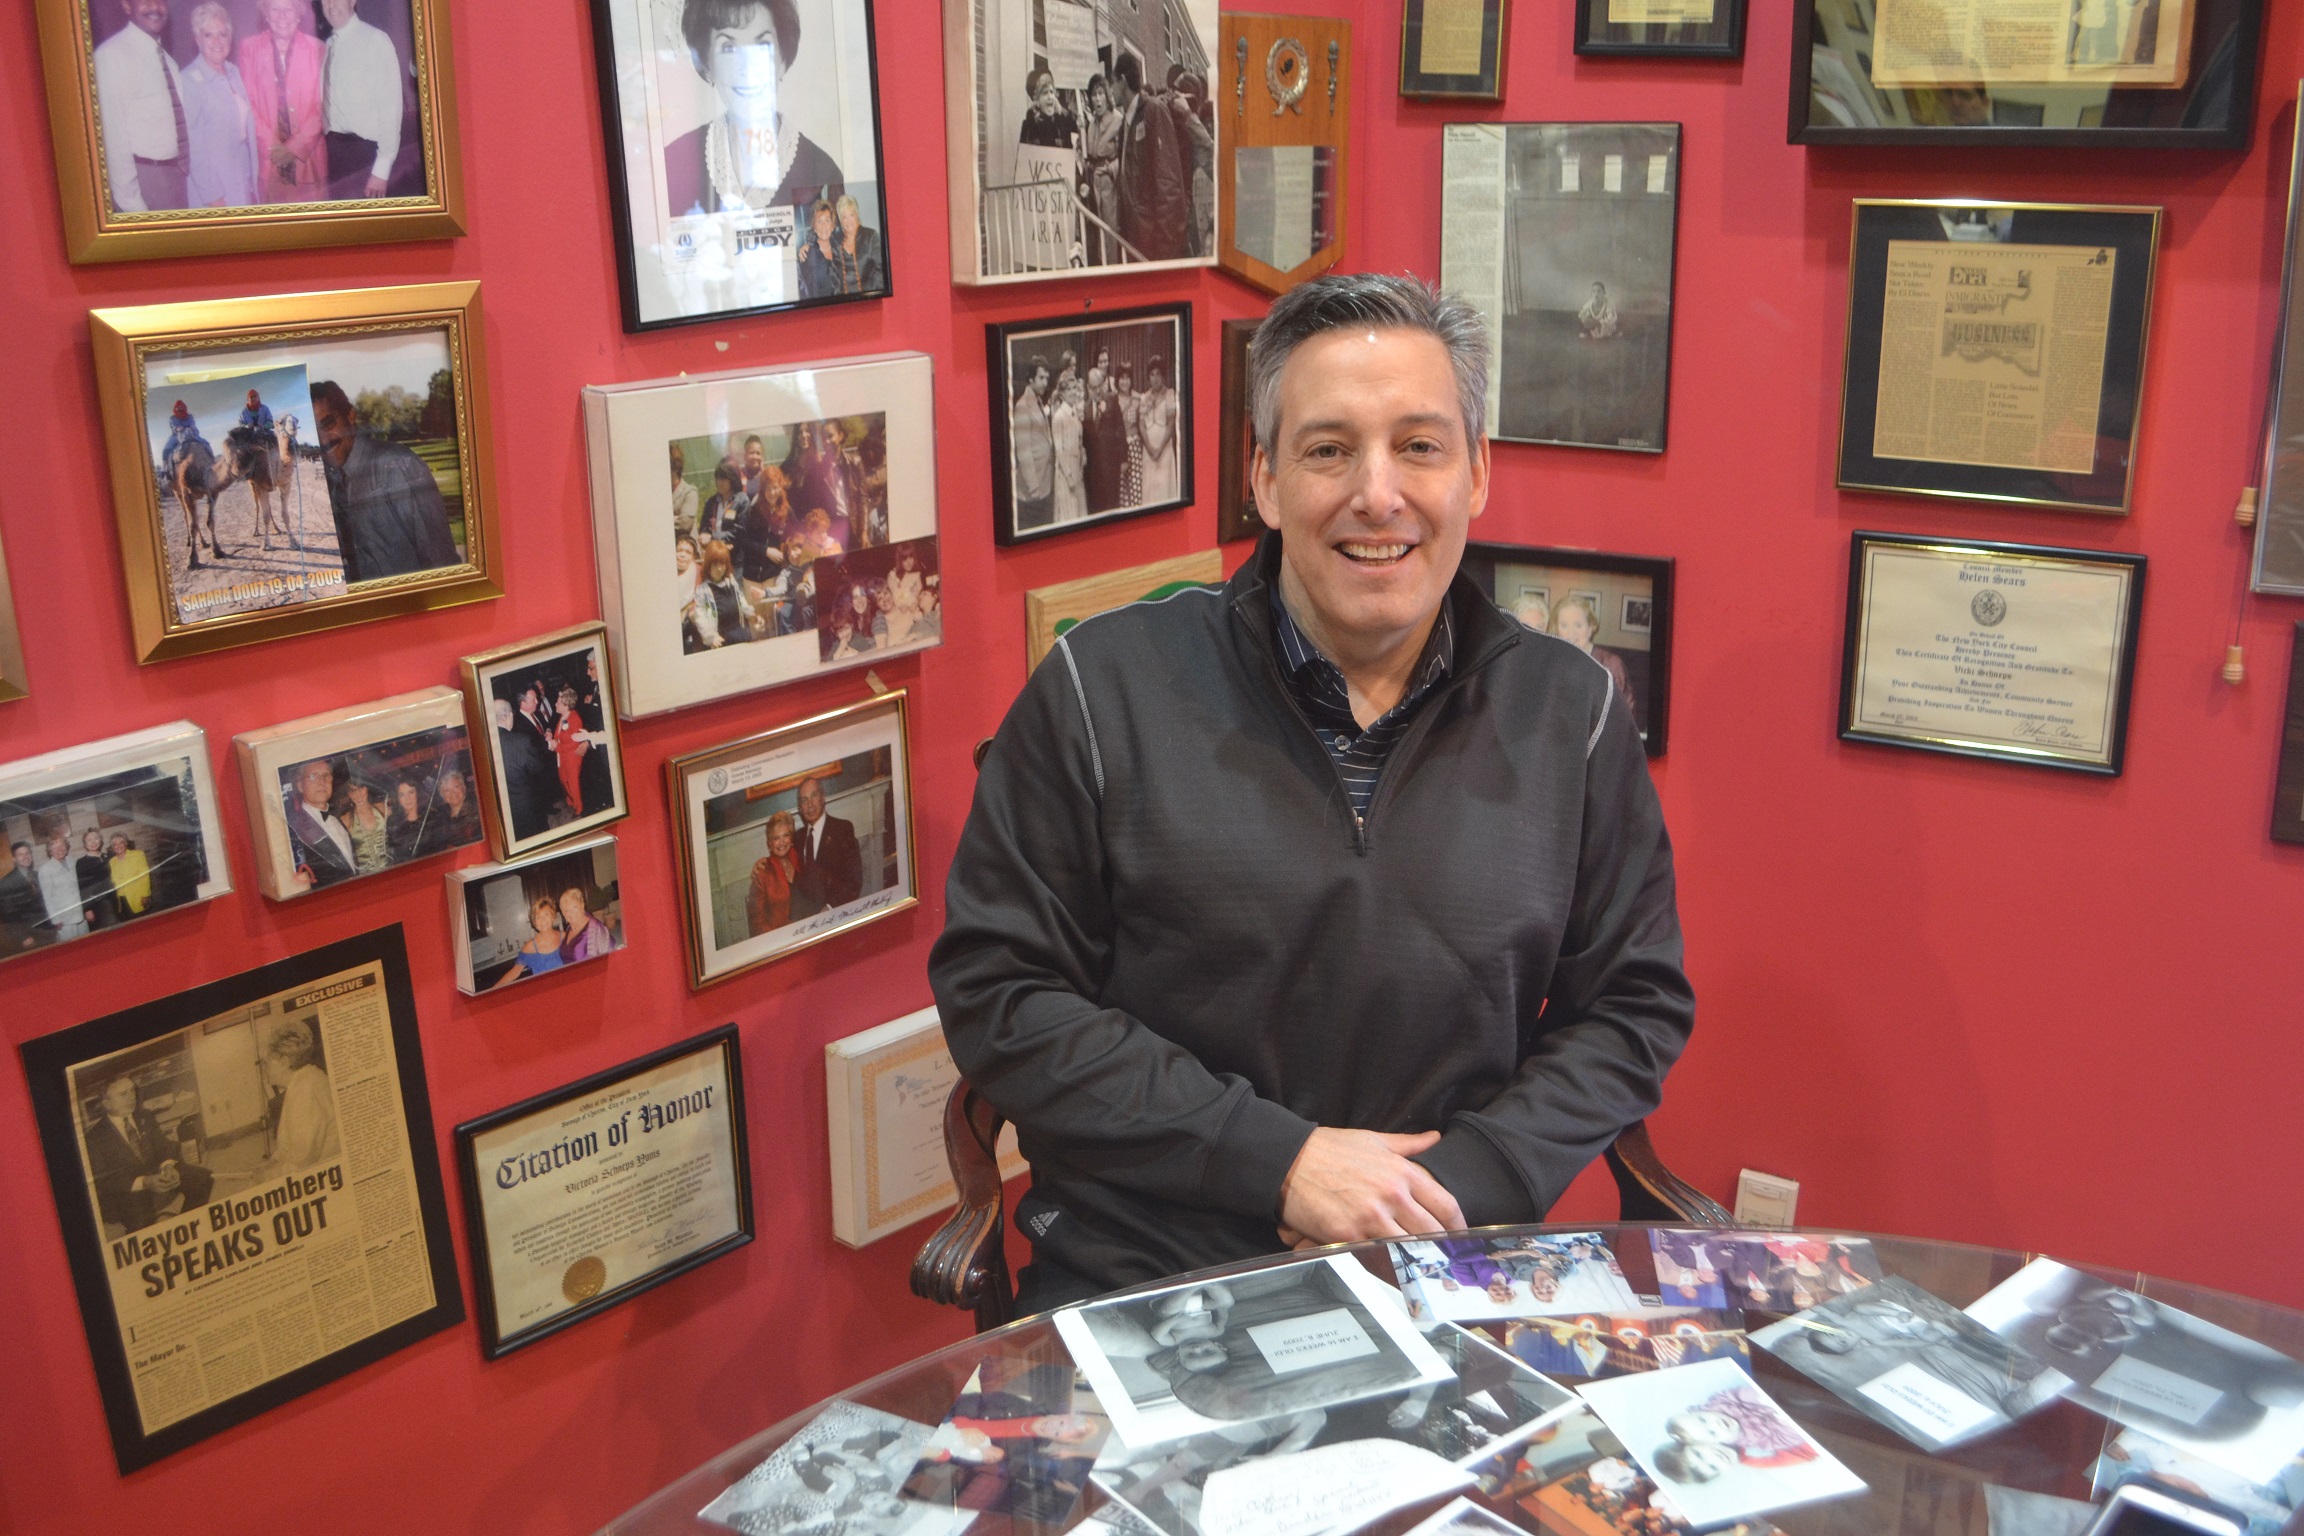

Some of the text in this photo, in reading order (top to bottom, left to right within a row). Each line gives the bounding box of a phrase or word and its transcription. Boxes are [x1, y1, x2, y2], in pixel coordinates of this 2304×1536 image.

[734, 232, 793, 256] JUDY
[181, 569, 344, 612] SAHARA DOUZ 19-04-2009
[1959, 571, 2026, 587] Helen Sears
[1936, 634, 2038, 653] The New York City Council
[1896, 648, 1912, 657] This
[1914, 650, 1949, 661] Certificate
[1964, 656, 2006, 668] Recognition
[2024, 663, 2060, 675] Gratitude
[1954, 665, 2012, 680] Vicki Schneps
[1892, 679, 1910, 689] Your
[1911, 681, 1953, 694] Outstanding
[2004, 692, 2045, 704] Community
[2046, 698, 2073, 708] Service
[1887, 695, 1921, 707] Providing
[1924, 699, 1962, 711] Inspiration
[1977, 705, 2003, 716] Women
[2004, 707, 2046, 721] Throughout
[2047, 714, 2075, 726] Queens
[295, 977, 364, 1008] EXCLUSIVE
[495, 1084, 714, 1190] Citation of Honor
[564, 1174, 599, 1194] Victoria
[601, 1160, 635, 1180] Schneps
[112, 1218, 201, 1271] Mayor
[208, 1164, 344, 1233] Bloomberg
[1030, 1216, 1047, 1237] adidas
[141, 1222, 265, 1299] SPEAKS
[272, 1195, 328, 1246] OUT
[1296, 1343, 1326, 1352] WEEKS
[1339, 1336, 1351, 1344] AM
[134, 1359, 148, 1370] The
[150, 1349, 174, 1363] Mayor
